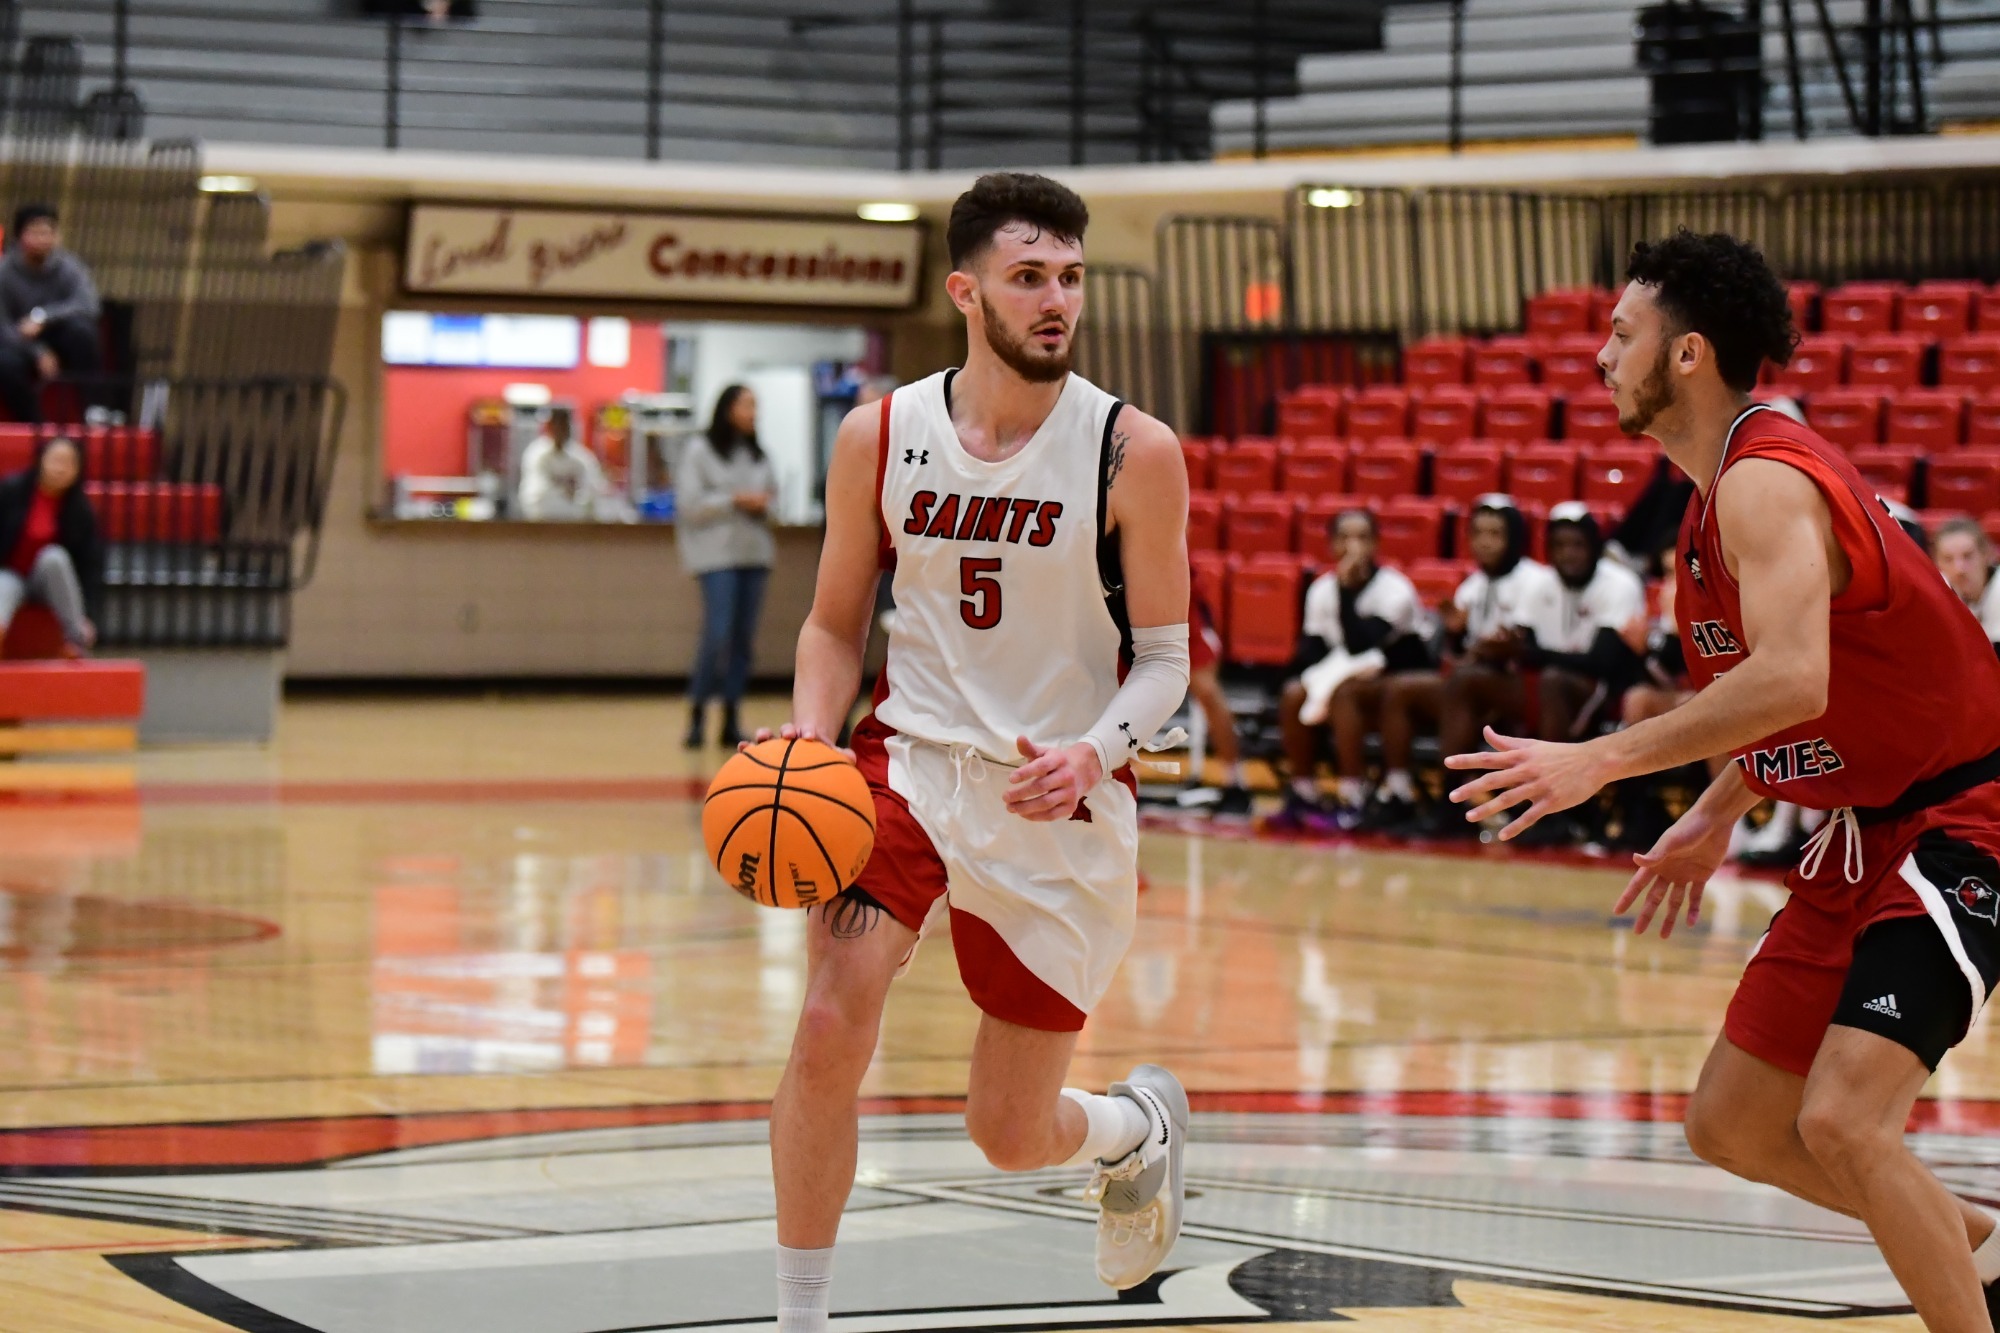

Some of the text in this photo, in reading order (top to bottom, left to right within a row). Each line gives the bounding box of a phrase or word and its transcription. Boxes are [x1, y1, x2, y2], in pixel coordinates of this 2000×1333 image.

[646, 231, 904, 286] Concessions
[903, 490, 1063, 547] SAINTS
[960, 556, 1002, 630] 5
[1862, 1001, 1902, 1019] adidas
